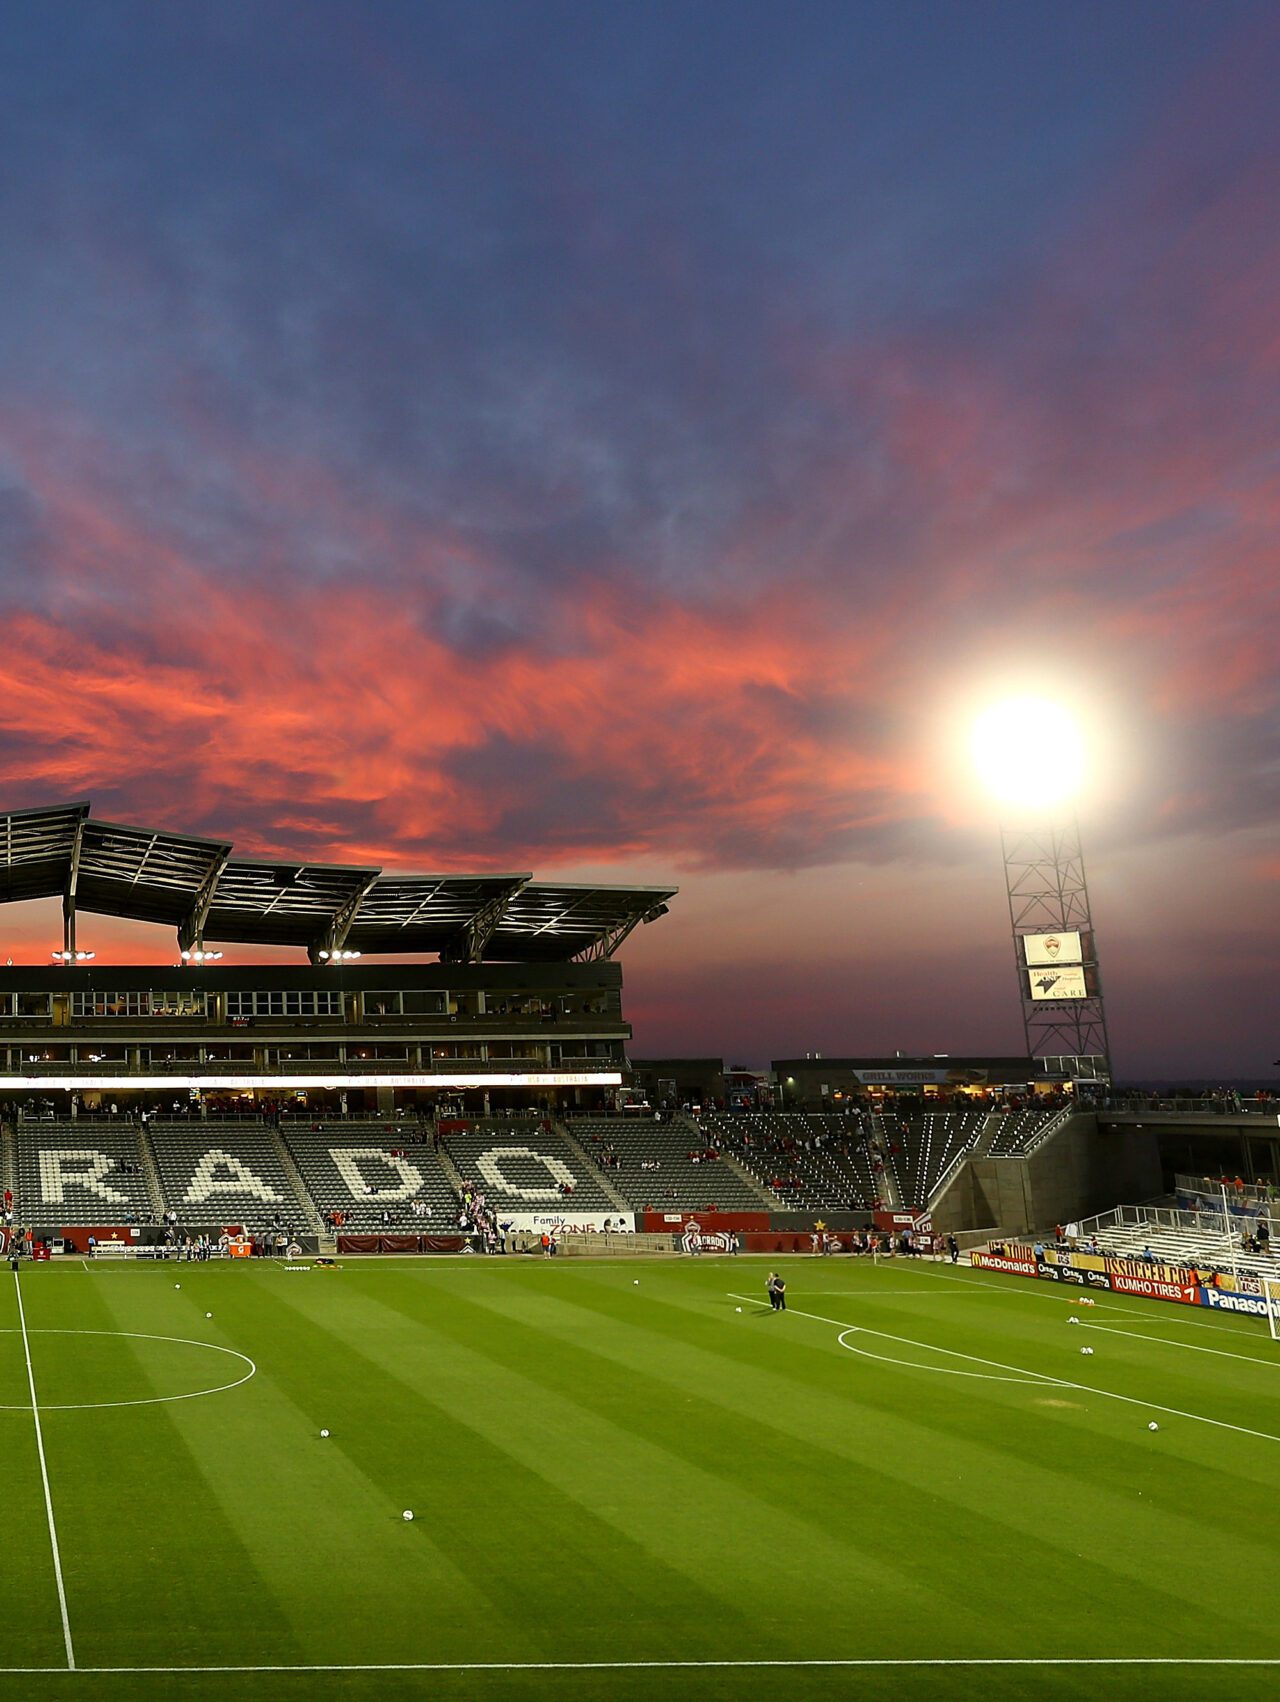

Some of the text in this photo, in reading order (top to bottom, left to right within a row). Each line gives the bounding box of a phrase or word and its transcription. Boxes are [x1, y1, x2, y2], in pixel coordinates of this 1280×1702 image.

[1052, 989, 1084, 997] CARE
[534, 1216, 566, 1226] Family
[550, 1224, 595, 1234] ZONE
[981, 1254, 1035, 1274] McDonald's
[1114, 1277, 1182, 1298] KUMHO TIRES
